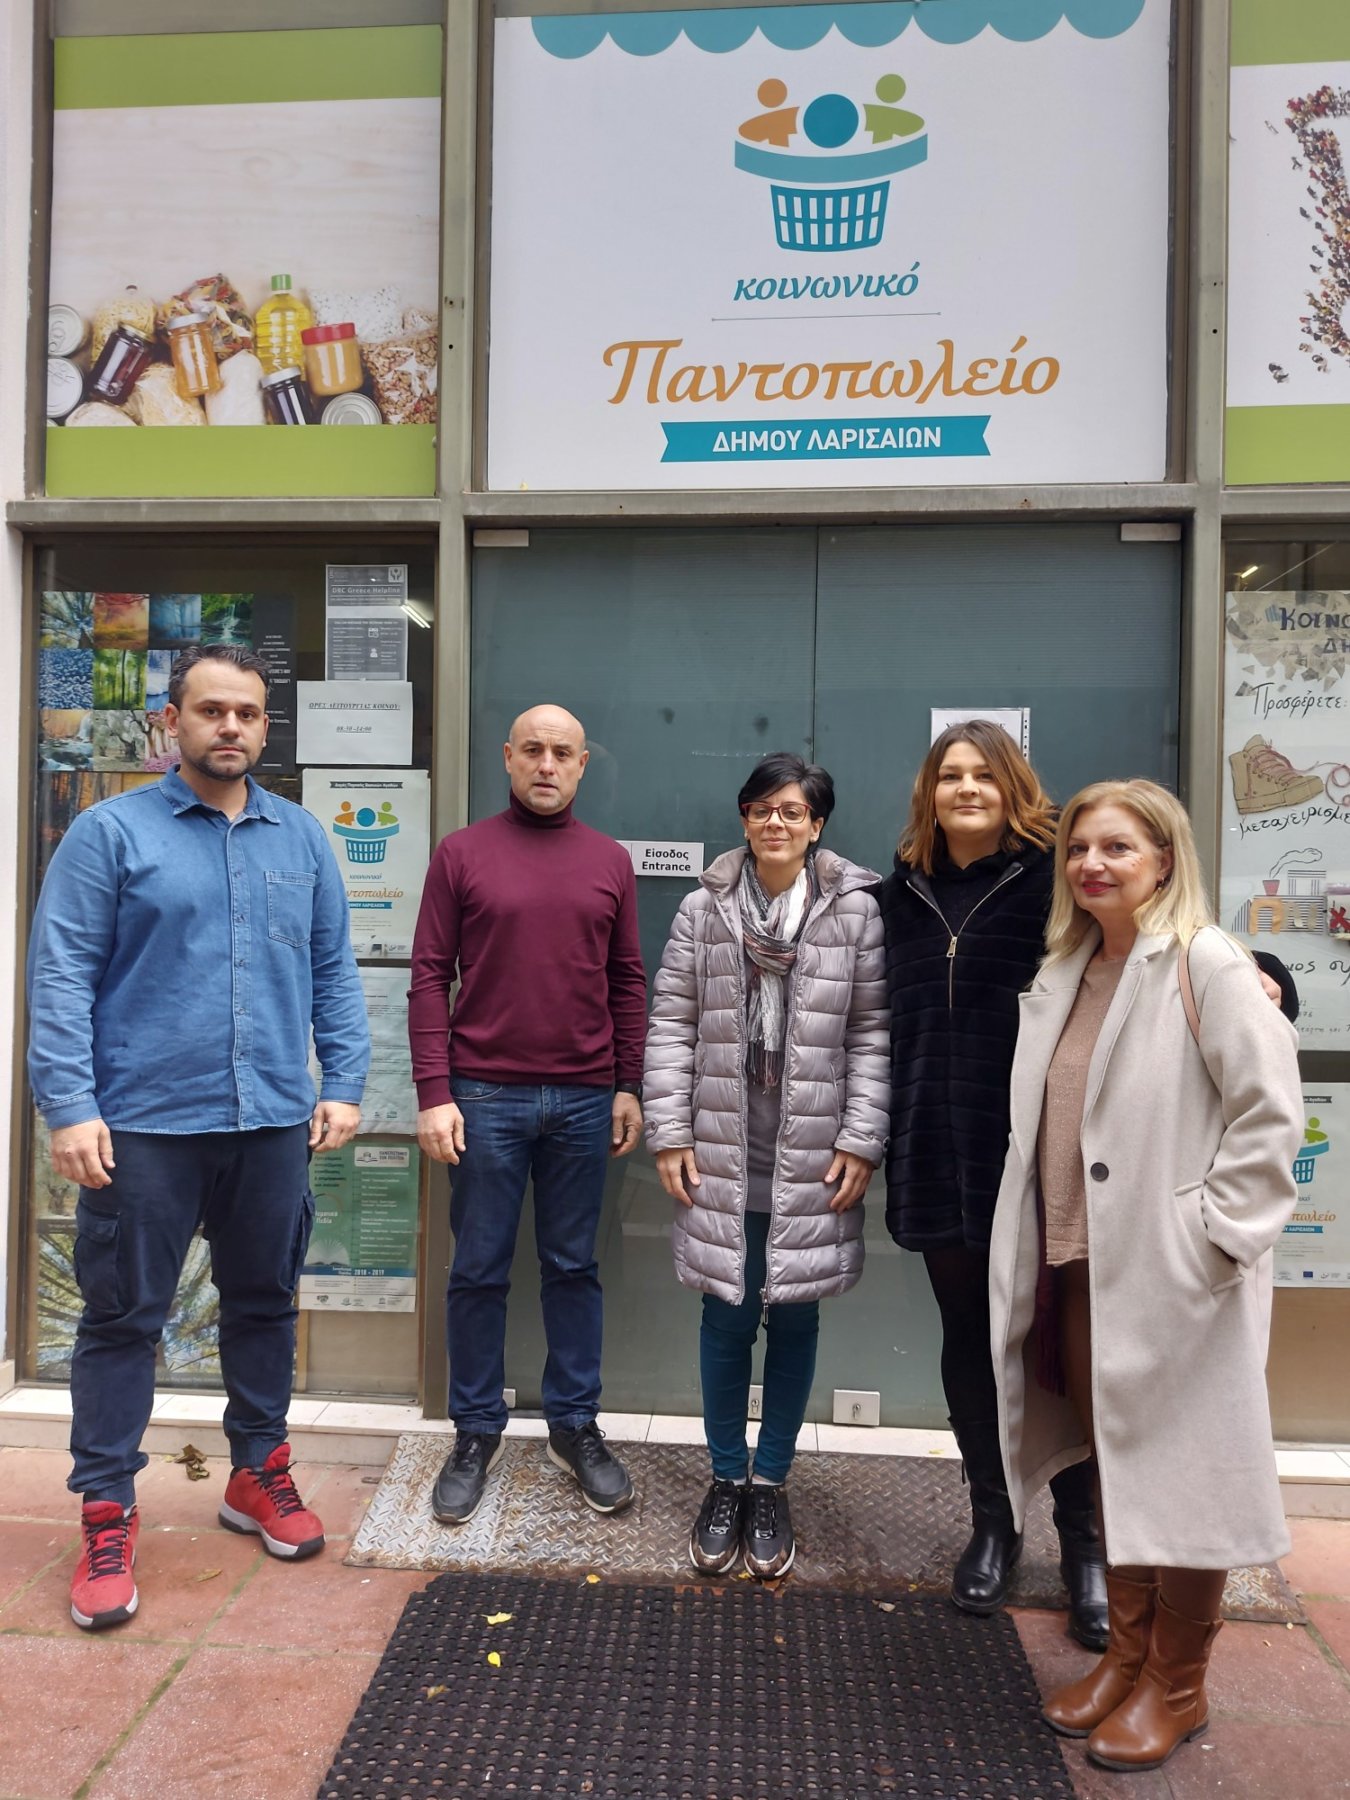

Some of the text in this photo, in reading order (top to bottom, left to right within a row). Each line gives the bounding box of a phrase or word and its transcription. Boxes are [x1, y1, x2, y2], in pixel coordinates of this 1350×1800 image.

[733, 261, 920, 302] κοινωνικό
[602, 335, 1061, 405] Παντοπωλείο
[712, 426, 942, 453] ΔΗΜΟΥ ΛΑΡΙΣΑΙΩΝ
[347, 586, 371, 594] Greece
[372, 586, 400, 594] Helpline
[645, 848, 689, 861] Είσοδος
[642, 861, 691, 872] Entrance
[346, 887, 404, 899] ντοπωλείο
